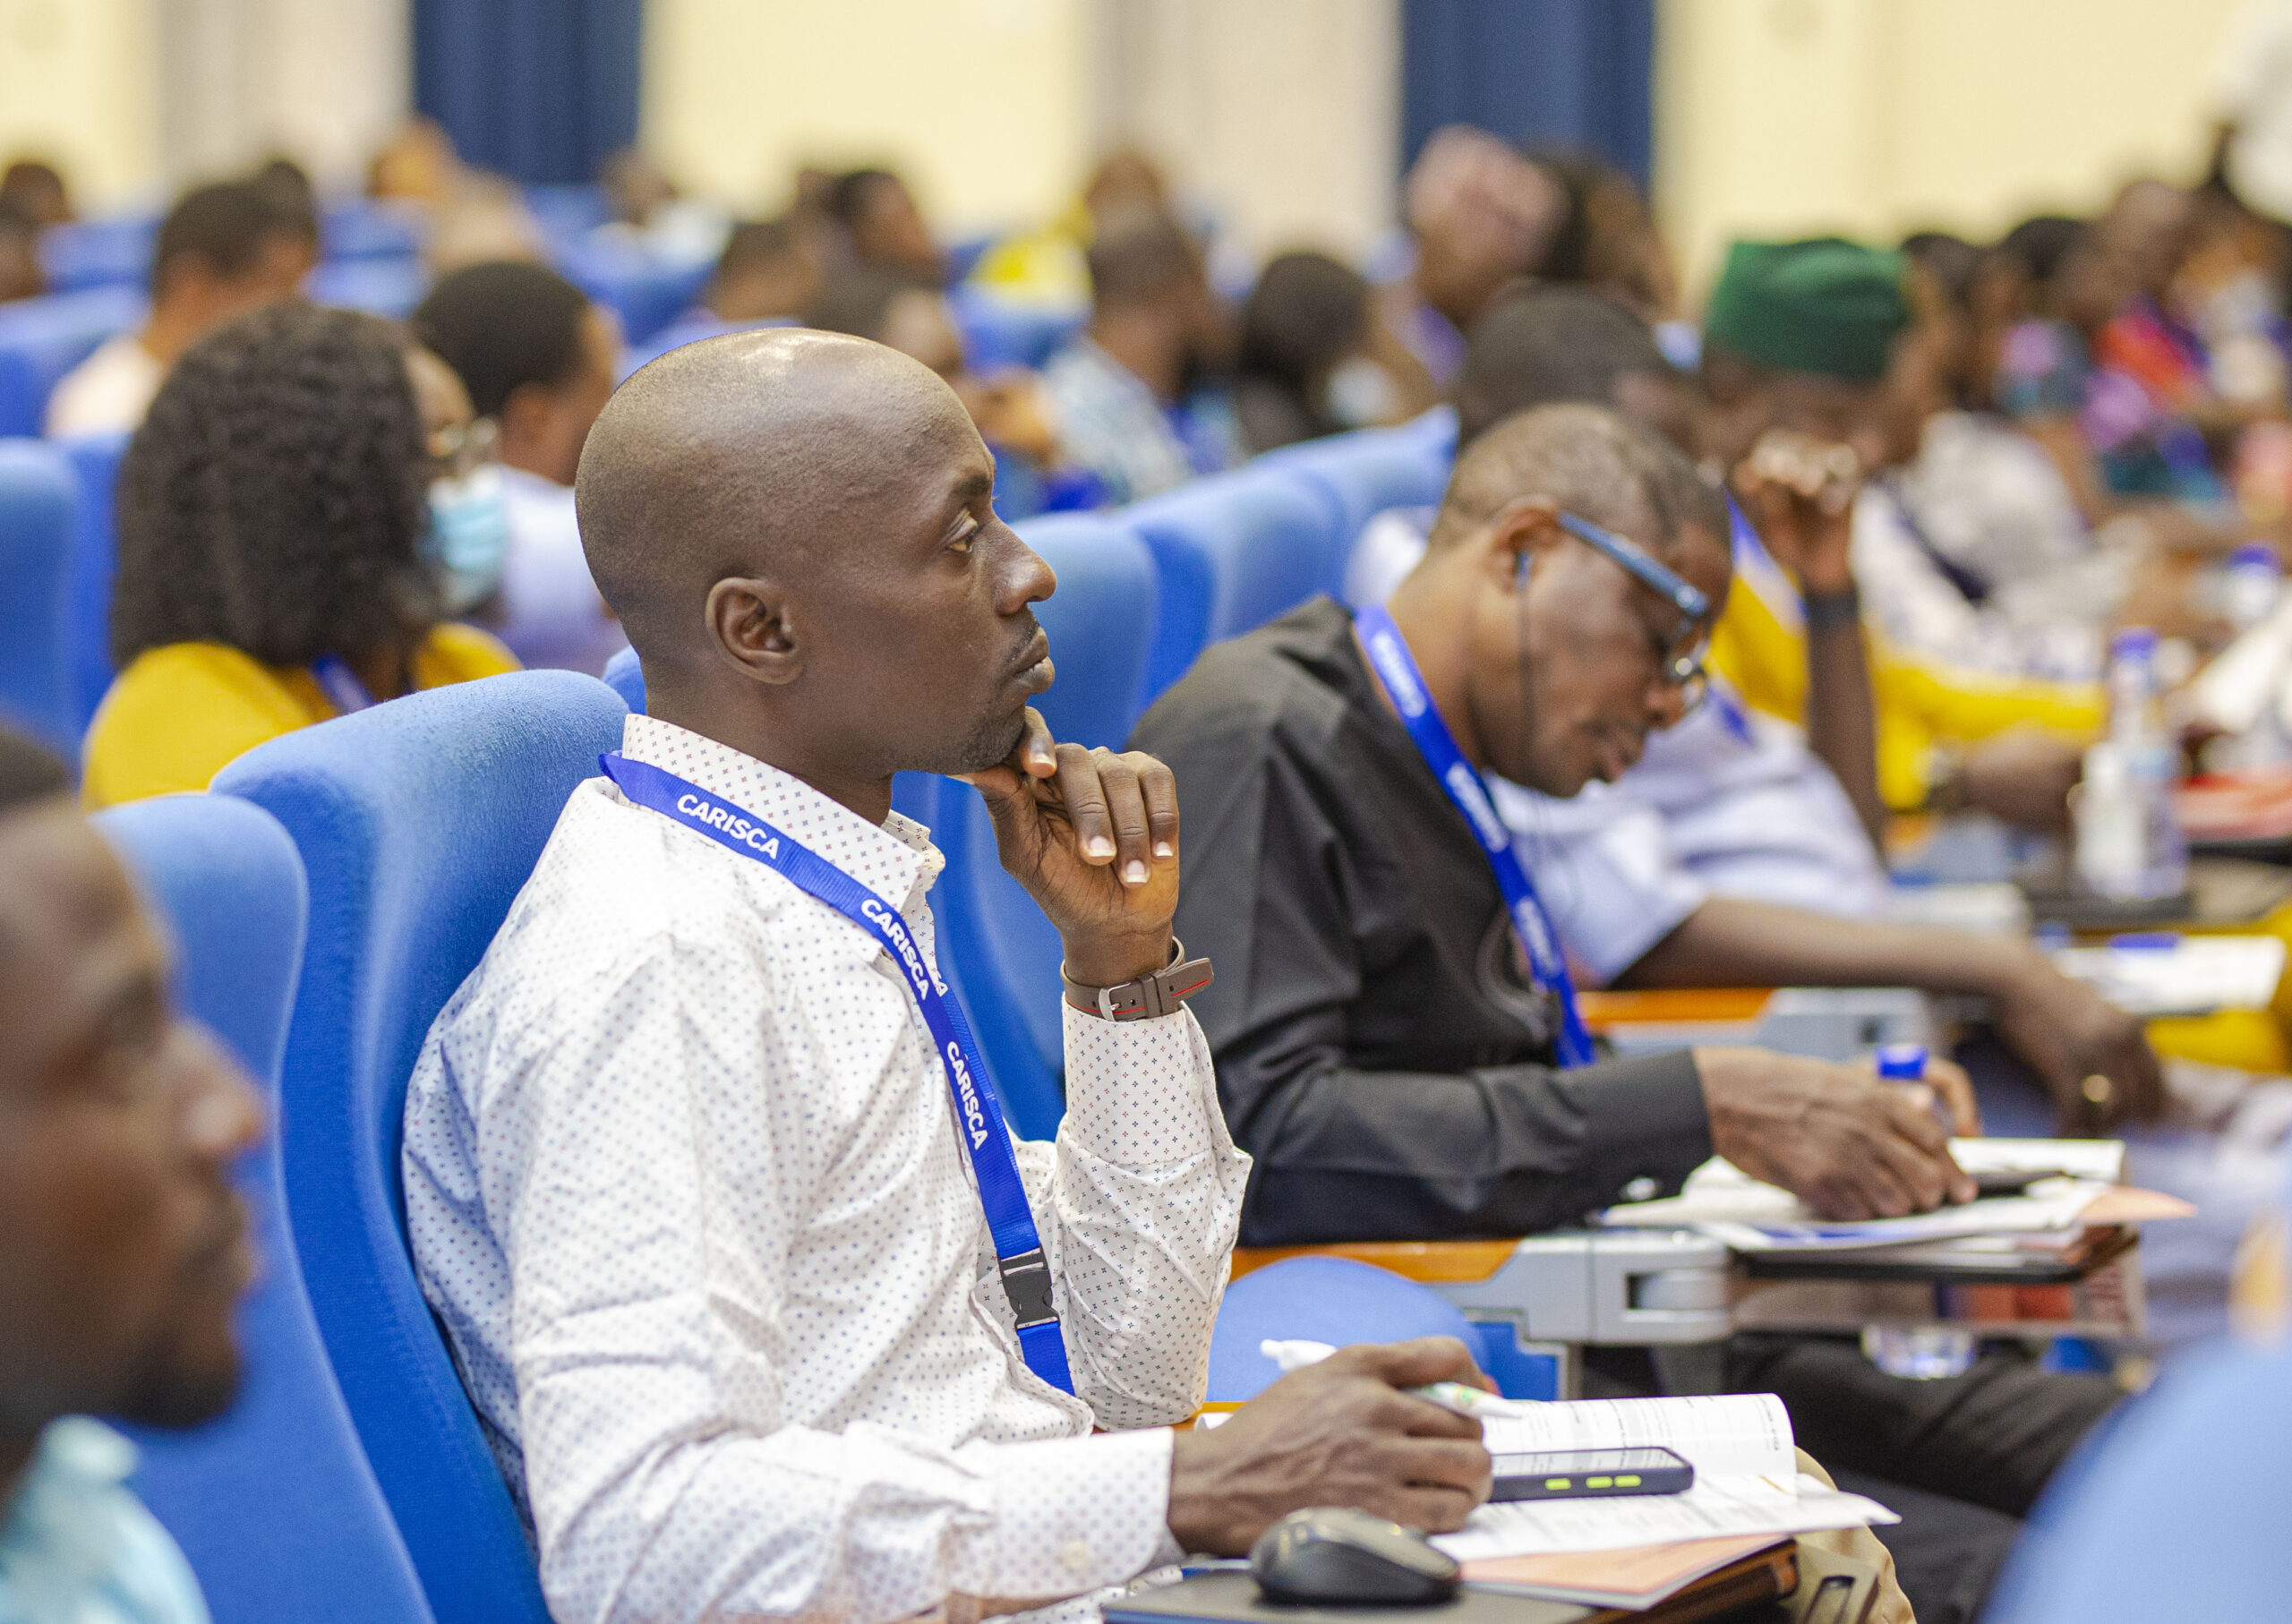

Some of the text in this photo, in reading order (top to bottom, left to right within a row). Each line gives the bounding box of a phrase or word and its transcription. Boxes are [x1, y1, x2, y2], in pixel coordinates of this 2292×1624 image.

[677, 793, 780, 859] CARISCA
[860, 898, 929, 1001] CARISCA
[946, 1040, 988, 1150] CARISCA
